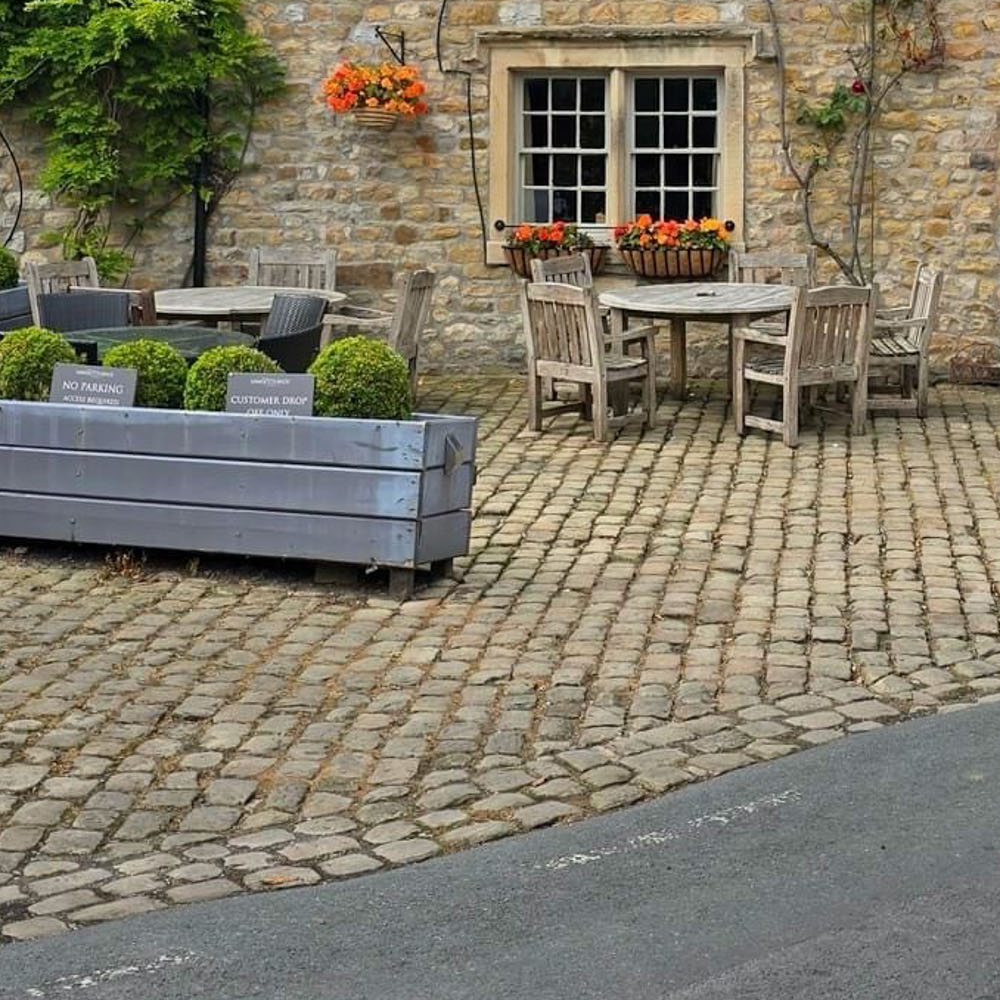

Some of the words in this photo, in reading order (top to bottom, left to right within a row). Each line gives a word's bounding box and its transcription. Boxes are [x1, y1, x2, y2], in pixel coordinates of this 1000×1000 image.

[62, 380, 79, 390] NO
[80, 382, 124, 395] PARKING
[230, 395, 280, 405] CUSTOMER
[282, 396, 308, 405] DROP
